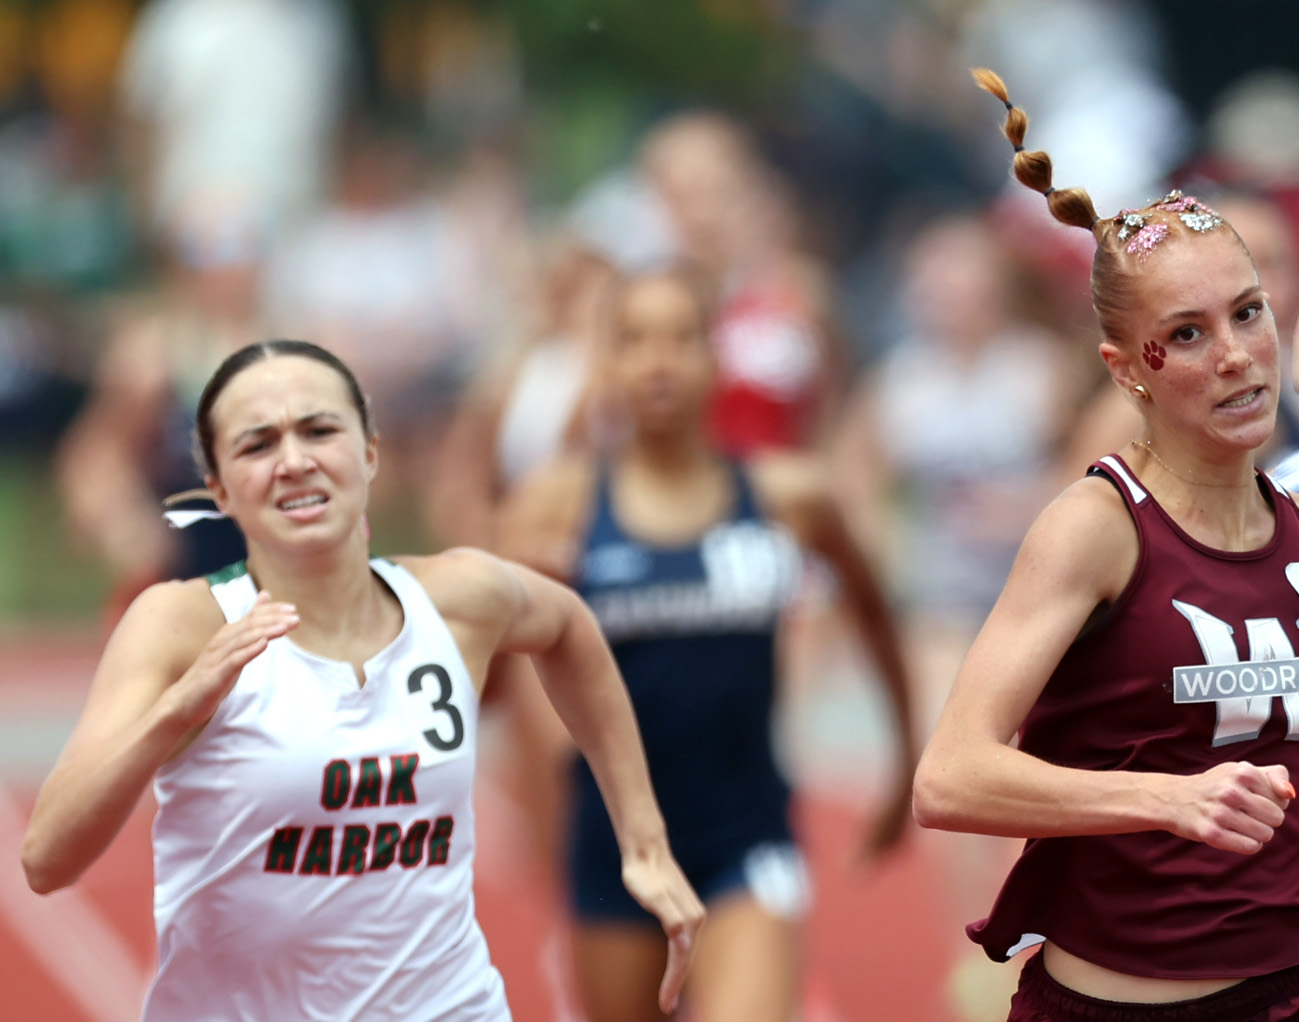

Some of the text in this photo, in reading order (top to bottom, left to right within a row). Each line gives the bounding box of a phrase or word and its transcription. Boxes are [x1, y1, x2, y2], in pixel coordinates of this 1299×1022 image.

[407, 663, 464, 752] 3
[320, 752, 420, 813] OAK
[263, 814, 454, 877] HARBOR
